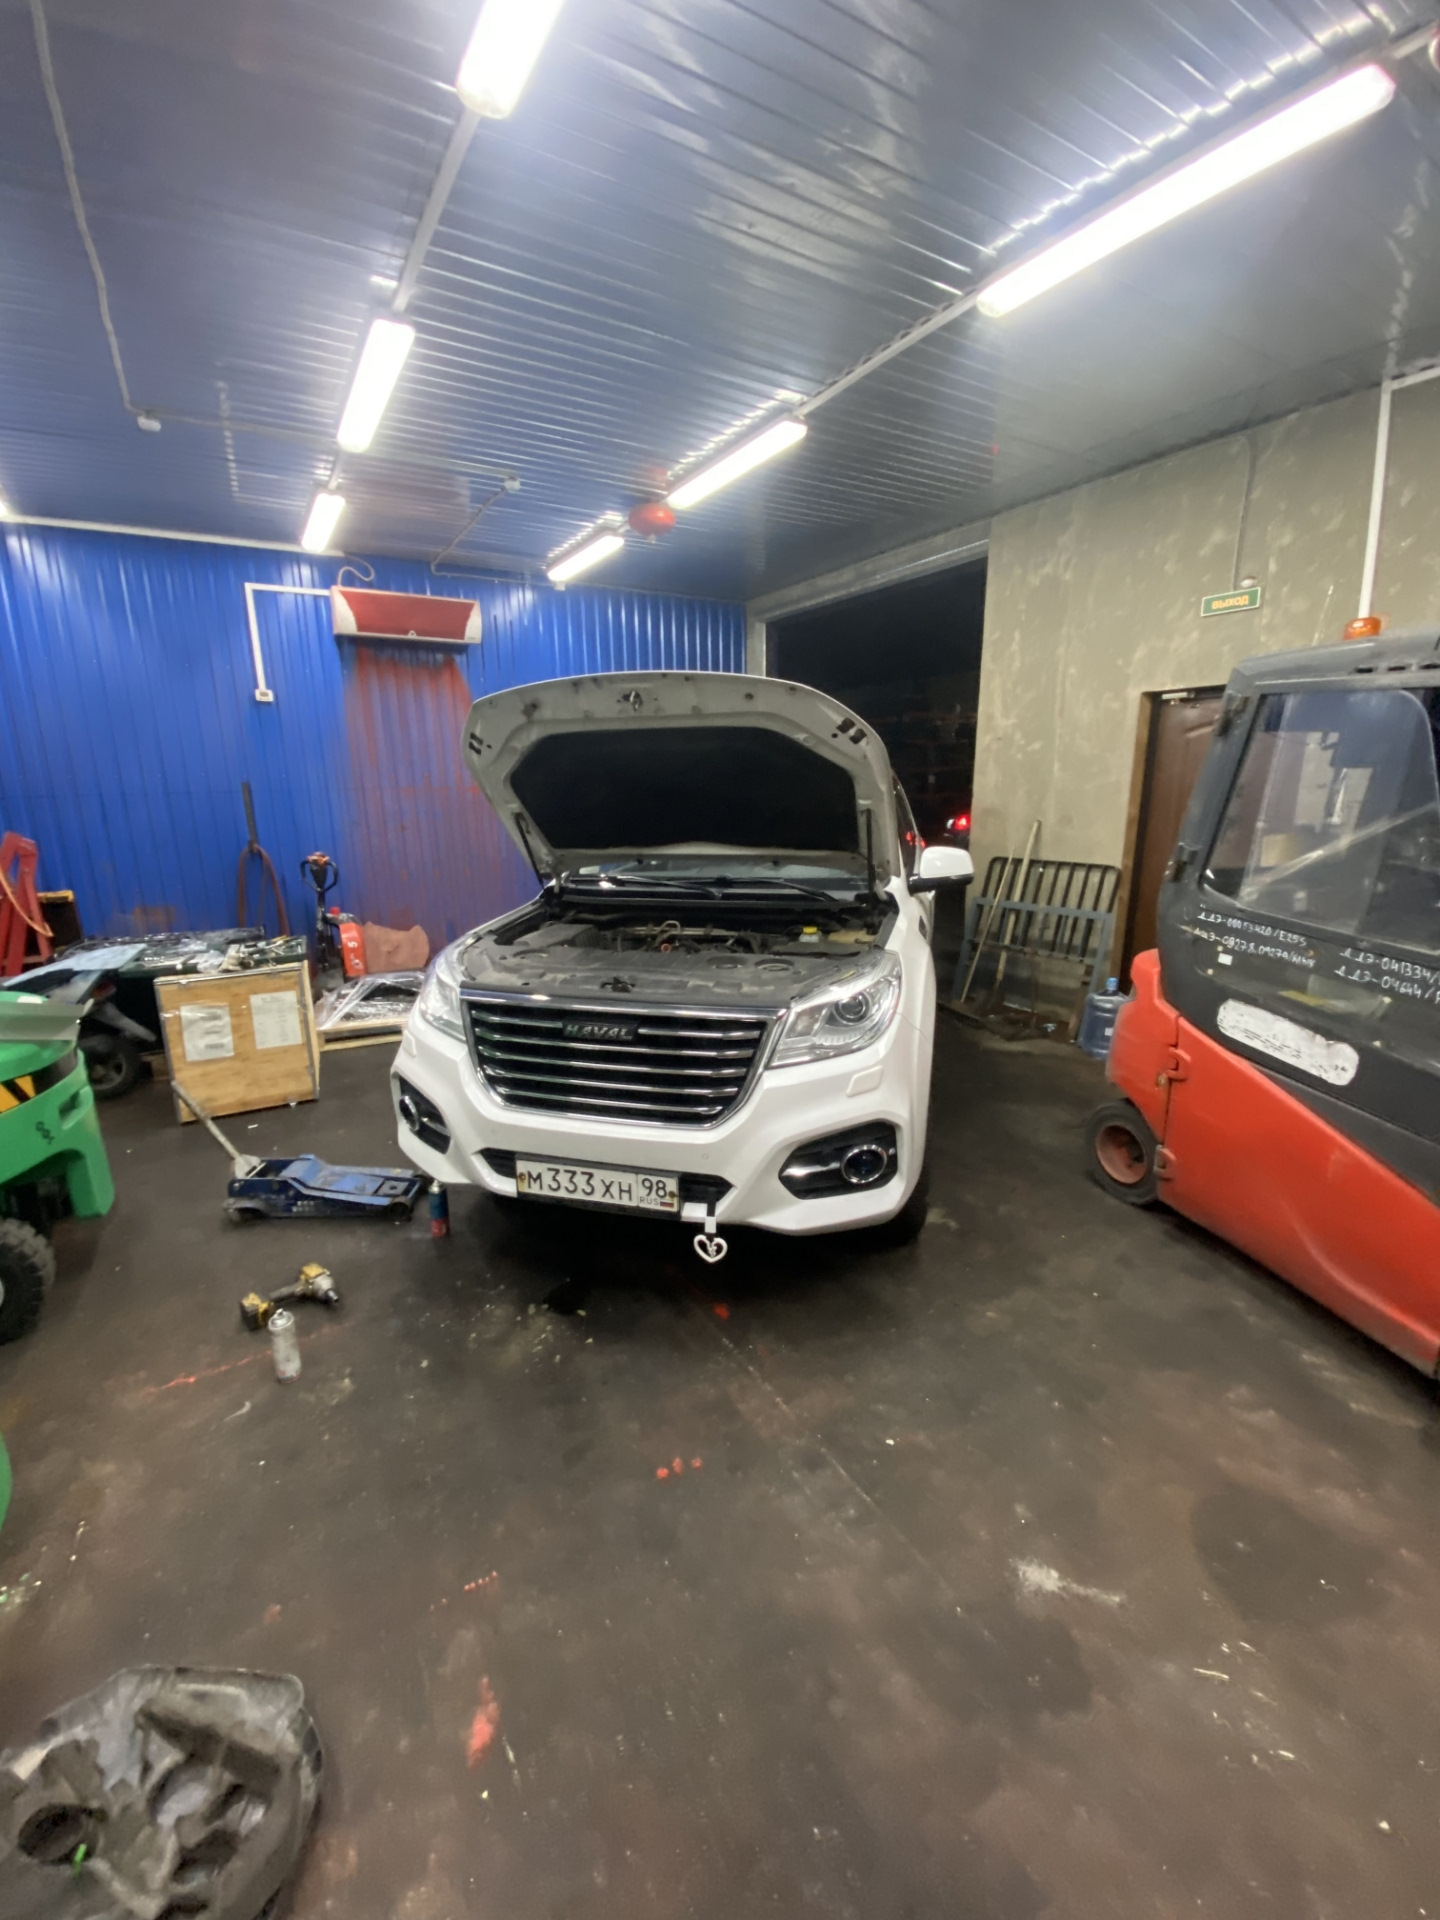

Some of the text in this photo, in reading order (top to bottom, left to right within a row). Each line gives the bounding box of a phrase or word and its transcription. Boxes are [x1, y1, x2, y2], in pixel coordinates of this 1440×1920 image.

[1212, 595, 1249, 610] ВЫХОД
[564, 1024, 633, 1040] HAVAL
[641, 1177, 668, 1199] 98
[639, 1196, 660, 1206] RUS
